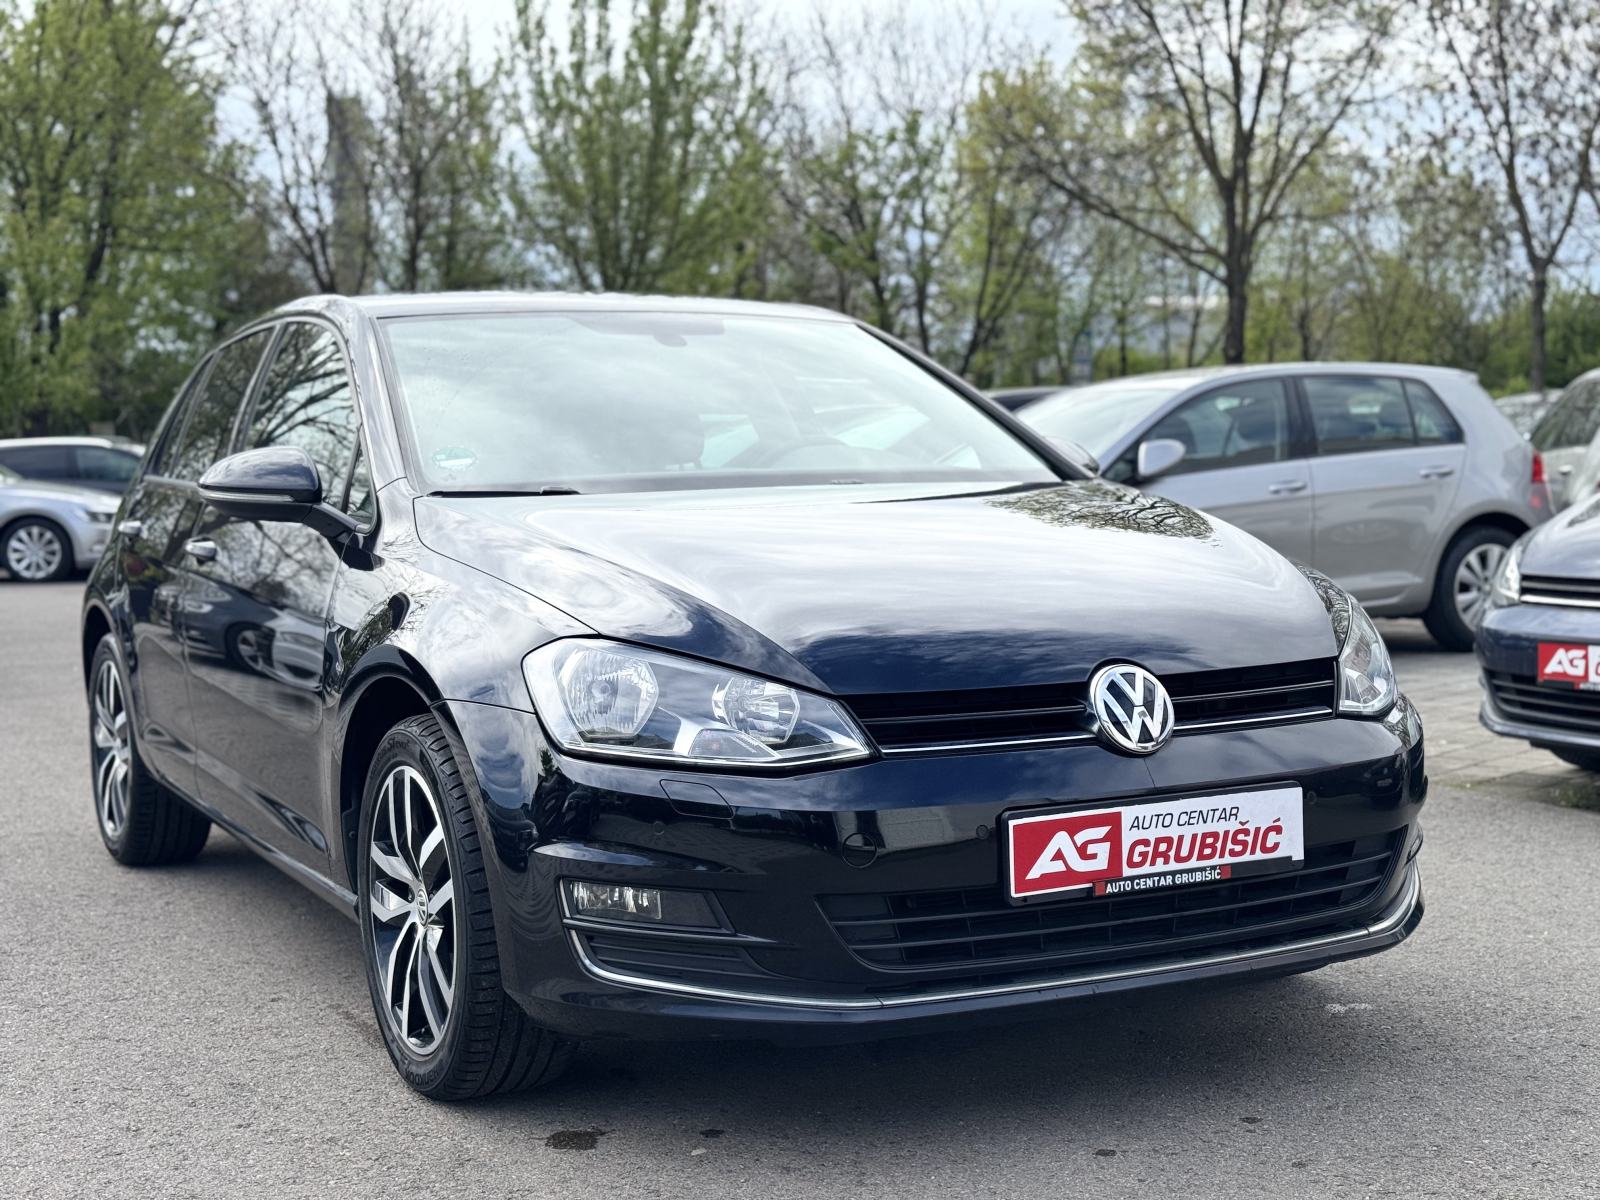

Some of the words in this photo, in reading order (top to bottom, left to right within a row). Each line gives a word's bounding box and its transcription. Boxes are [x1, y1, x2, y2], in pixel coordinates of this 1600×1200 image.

[1543, 648, 1586, 676] AG
[1090, 664, 1174, 753] VW
[1129, 812, 1174, 831] AUTO
[1177, 806, 1240, 827] CENTAR
[1025, 825, 1113, 880] AG
[1126, 817, 1283, 869] GRUBIŠIĆ
[1105, 881, 1132, 894] AUTO
[1134, 875, 1173, 889] CENTAR
[1175, 866, 1221, 884] GRUBIŠIĆ
